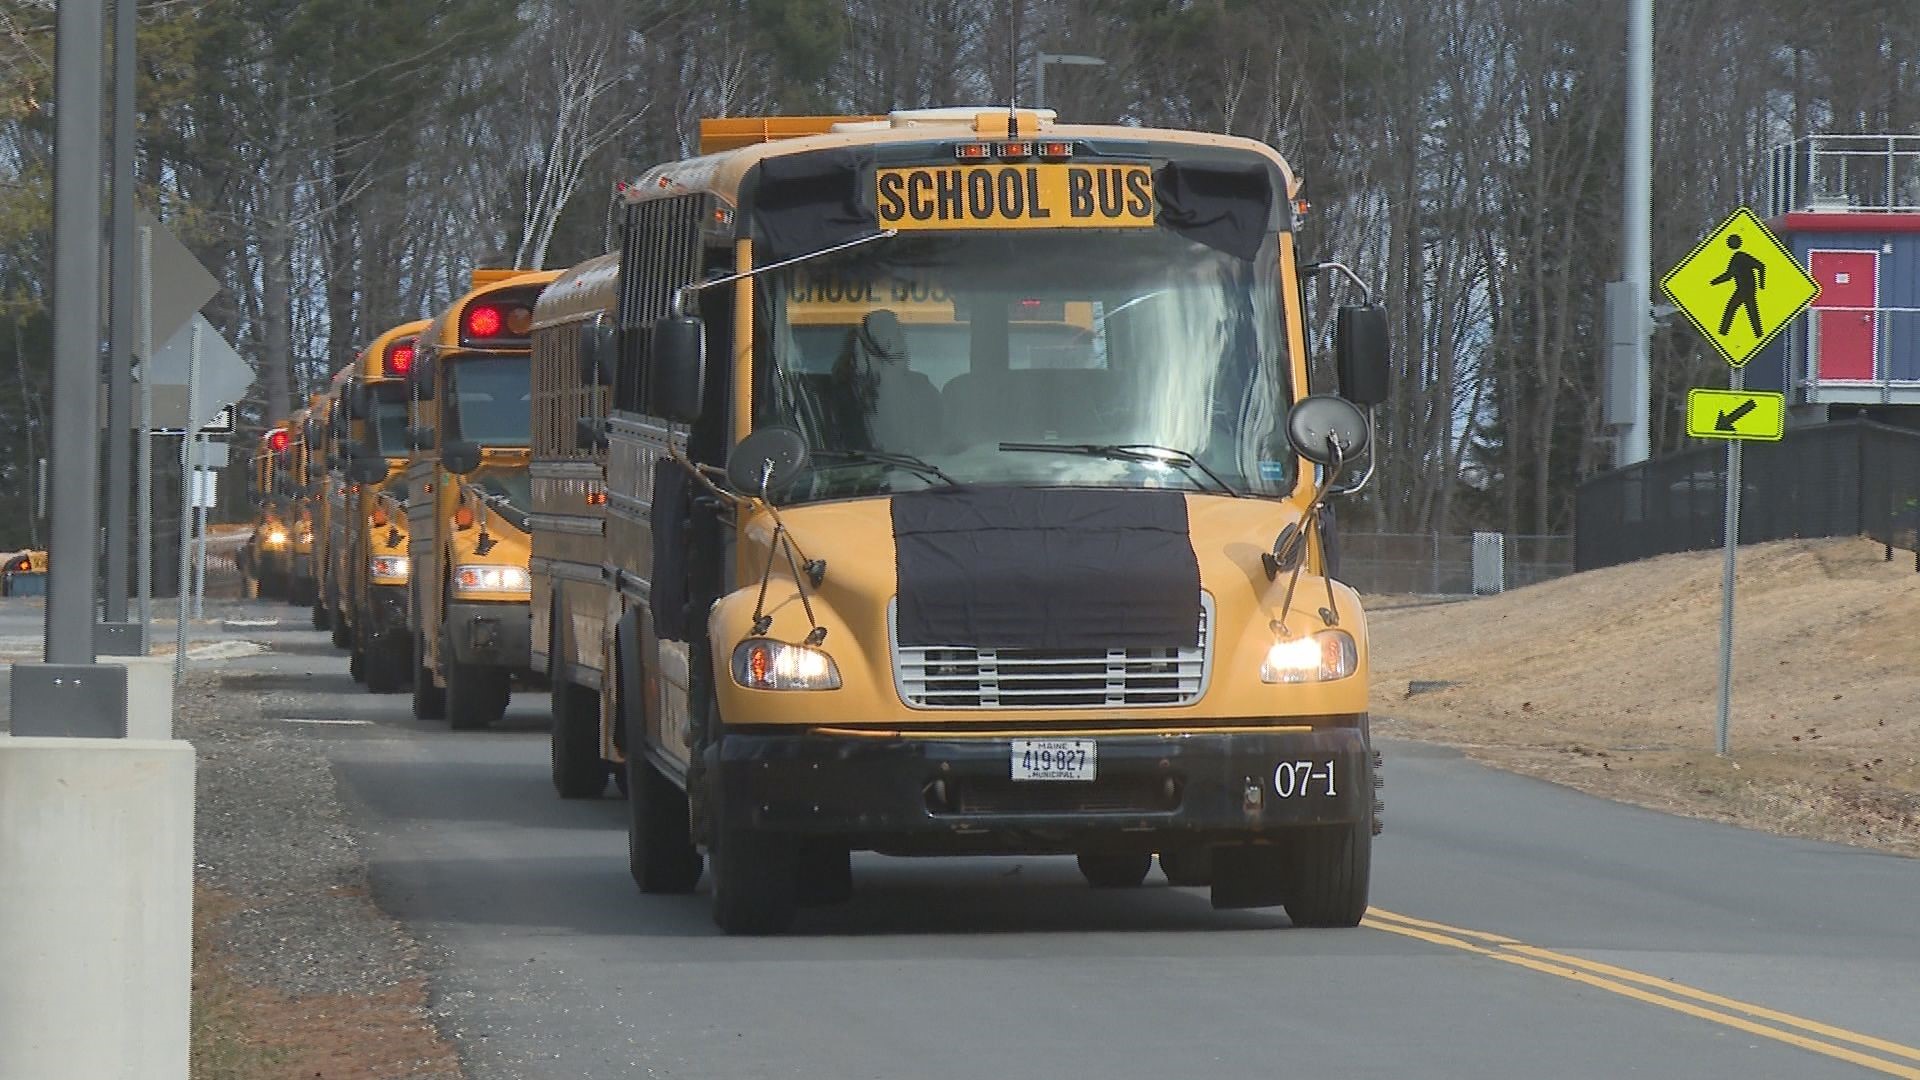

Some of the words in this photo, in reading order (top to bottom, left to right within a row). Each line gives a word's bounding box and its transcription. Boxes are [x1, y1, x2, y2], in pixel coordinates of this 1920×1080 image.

[879, 168, 1050, 221] SCHOOL
[1068, 168, 1152, 217] BUS
[1274, 760, 1337, 798] 07-1
